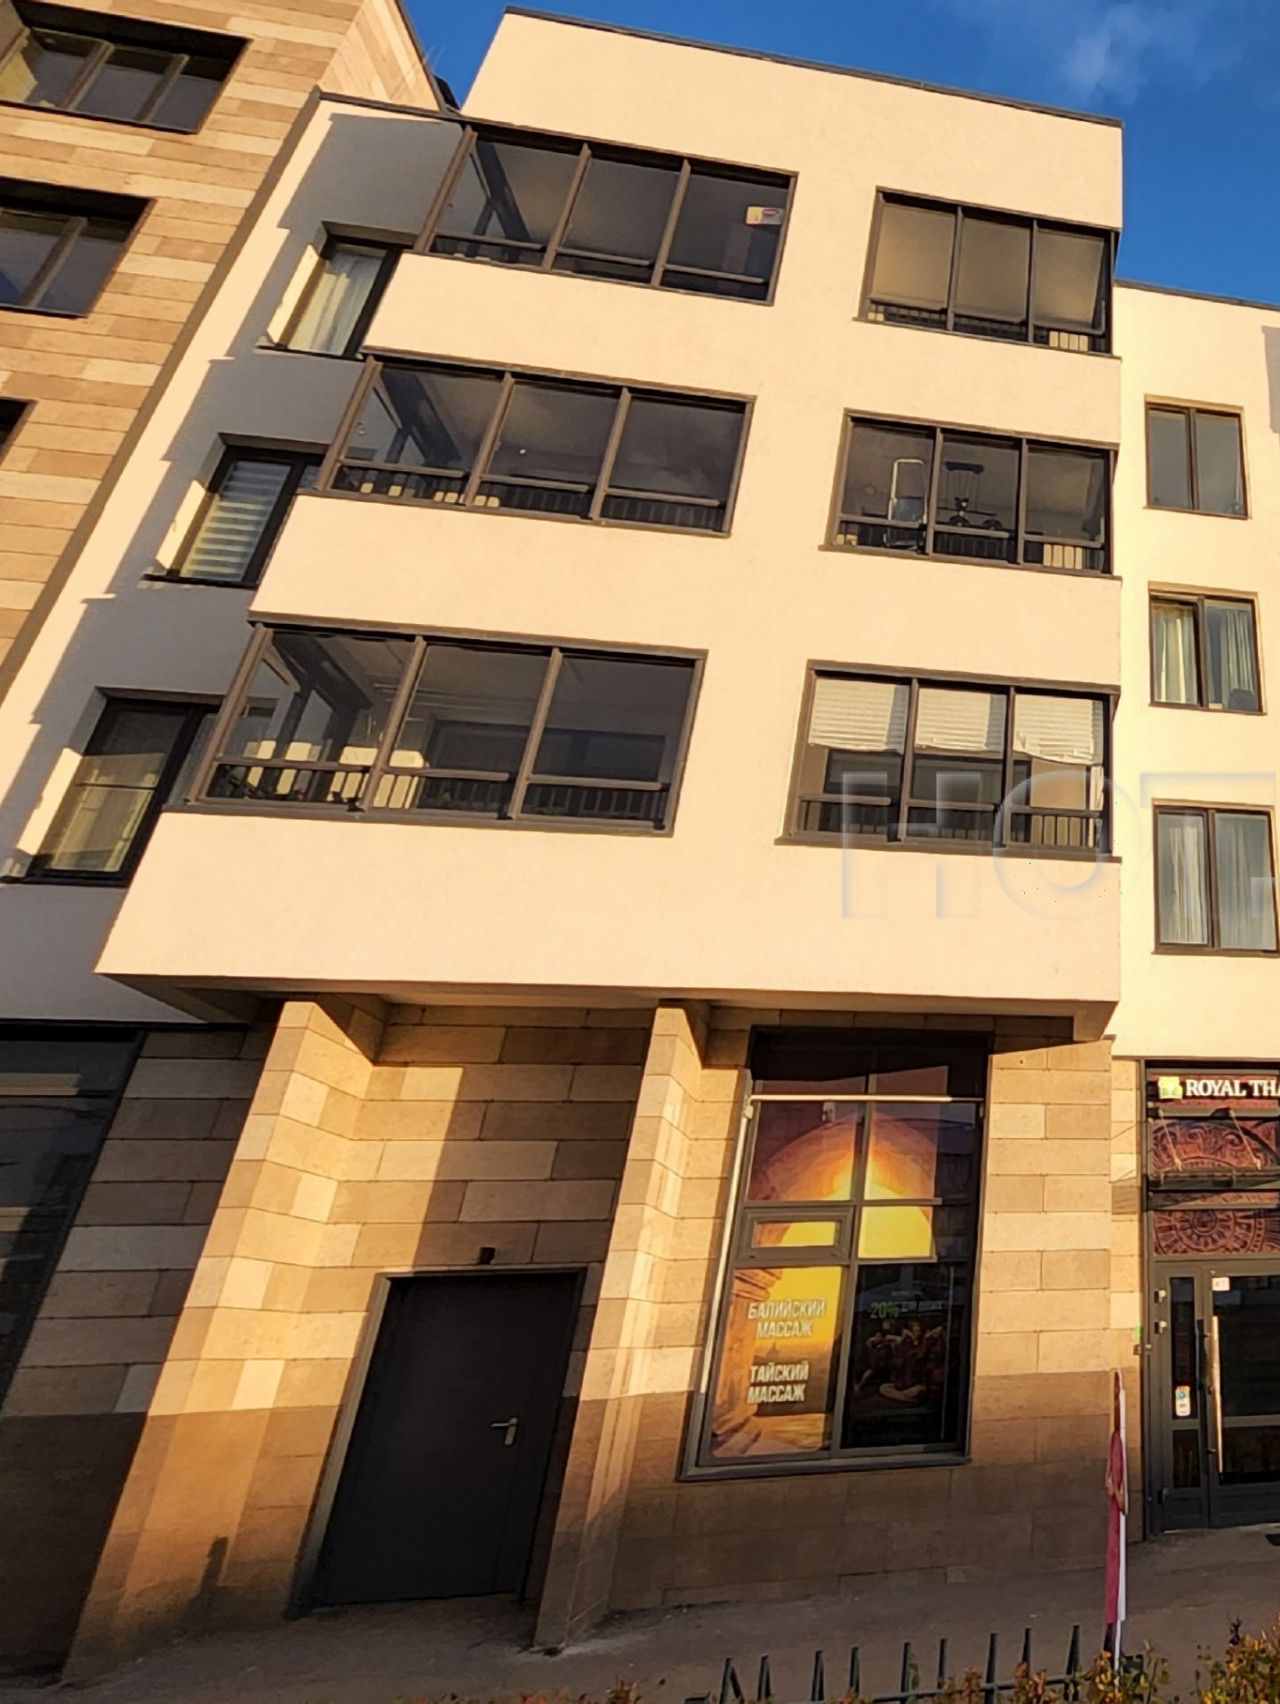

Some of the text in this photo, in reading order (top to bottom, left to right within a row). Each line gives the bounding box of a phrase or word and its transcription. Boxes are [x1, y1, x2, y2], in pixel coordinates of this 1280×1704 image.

[1185, 1079, 1247, 1097] ROYAL
[757, 1320, 813, 1338] МАССАЖ
[750, 1361, 809, 1384] ТАЙСКИЙ
[746, 1384, 806, 1404] МАССАЖ
